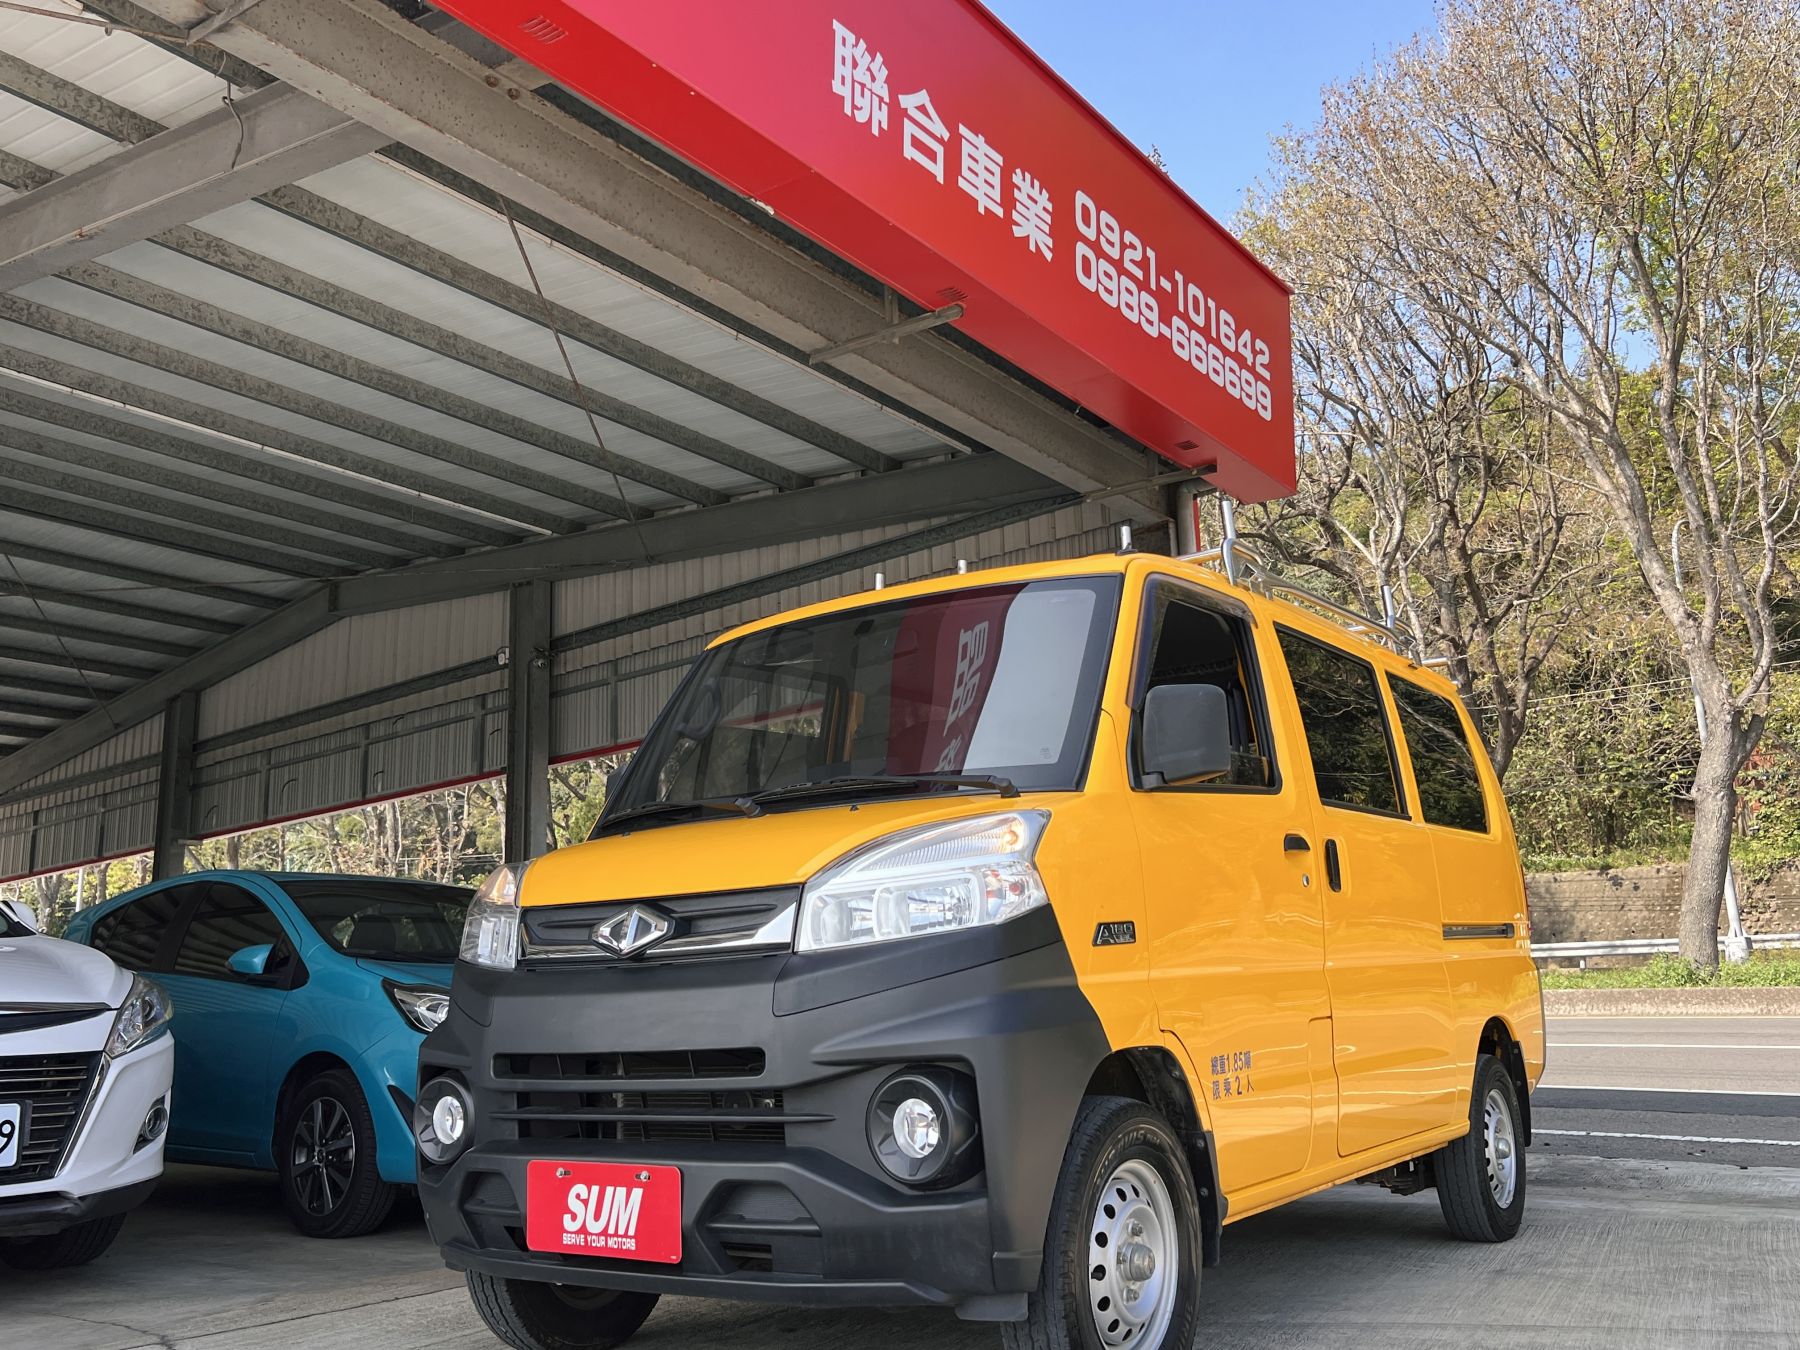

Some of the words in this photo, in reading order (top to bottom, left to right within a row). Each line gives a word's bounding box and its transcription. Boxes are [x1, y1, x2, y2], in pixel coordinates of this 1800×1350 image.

[832, 18, 1053, 262] 聯合車業
[1075, 190, 1271, 381] 0921-101642
[1075, 241, 1272, 421] 0989-666699
[562, 1184, 643, 1236] SUM
[562, 1233, 585, 1246] SERVE
[587, 1235, 605, 1248] YOUR
[607, 1237, 636, 1250] MOTORS
